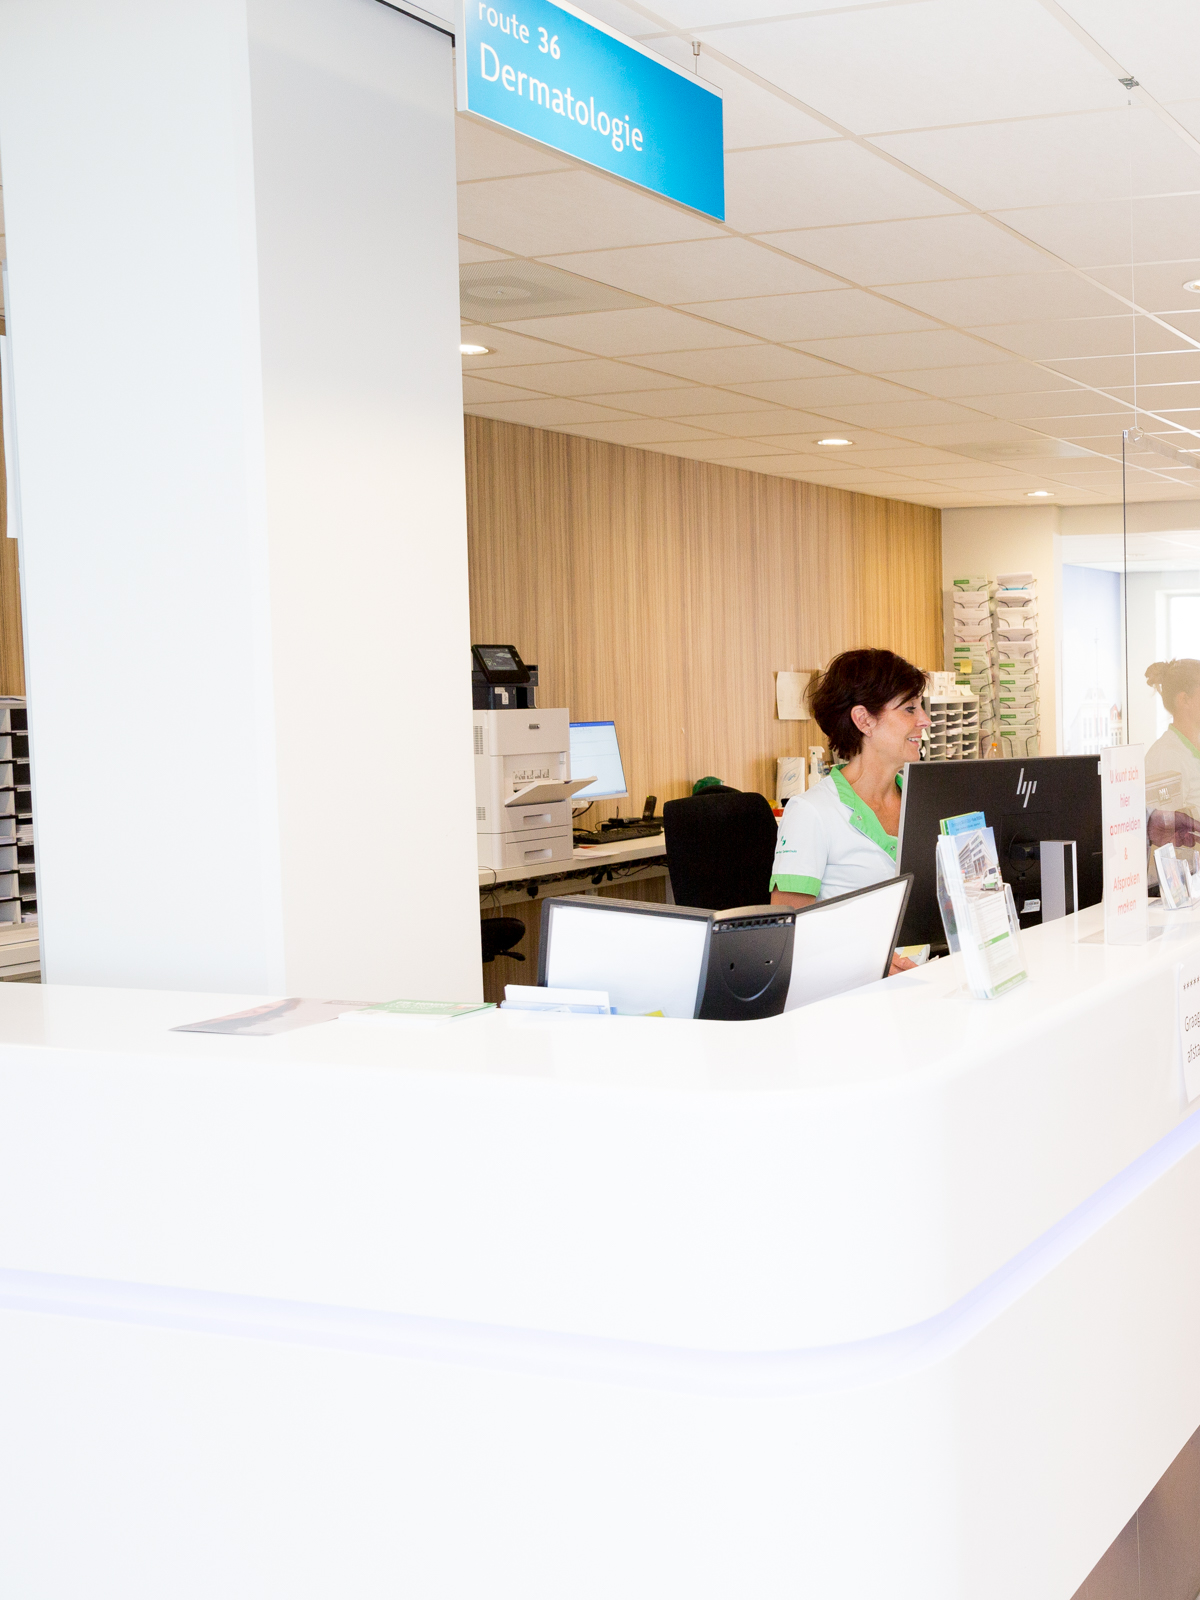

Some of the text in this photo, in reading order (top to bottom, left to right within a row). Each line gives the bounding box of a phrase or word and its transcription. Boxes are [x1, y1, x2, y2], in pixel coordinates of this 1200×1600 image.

[478, 1, 562, 60] route 36
[480, 41, 644, 153] Dermatologie
[1115, 767, 1128, 784] kunt
[1128, 766, 1139, 781] zich
[1016, 767, 1037, 808] hp
[1119, 793, 1131, 808] hier
[1109, 816, 1141, 836] aanmelden
[1123, 847, 1129, 861] &
[1113, 871, 1141, 893] Afspraken
[1117, 898, 1137, 917] maken
[1184, 1011, 1200, 1032] Graag
